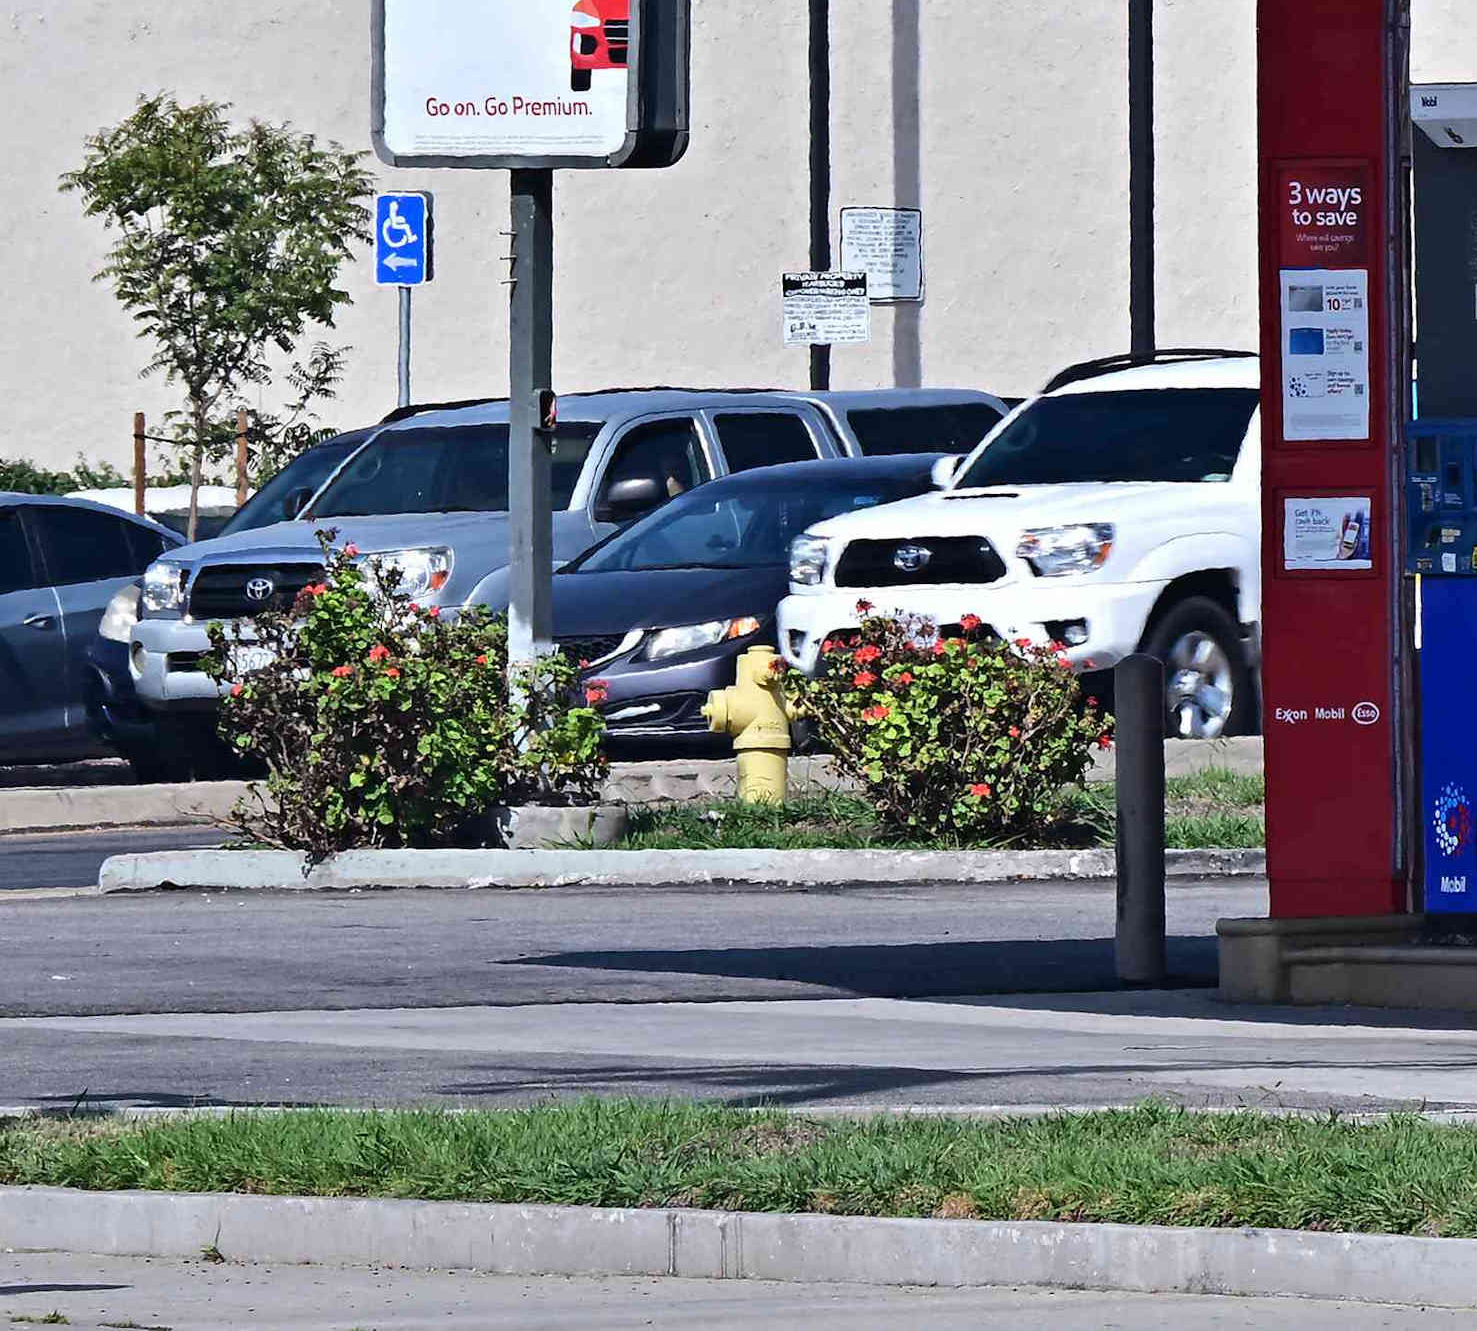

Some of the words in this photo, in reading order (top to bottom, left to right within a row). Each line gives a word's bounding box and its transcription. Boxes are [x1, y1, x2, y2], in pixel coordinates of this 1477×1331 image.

[426, 97, 450, 117] Go
[454, 101, 480, 116] on.
[484, 97, 509, 116] Go
[512, 95, 593, 116] Premium.
[1287, 181, 1302, 205] 3
[1305, 186, 1362, 211] ways
[1291, 209, 1312, 226] to
[1316, 211, 1358, 226] save
[1327, 298, 1341, 311] 10
[1275, 707, 1308, 724] Exxon
[1314, 707, 1345, 720] Mobil
[1440, 876, 1466, 894] Mobil
